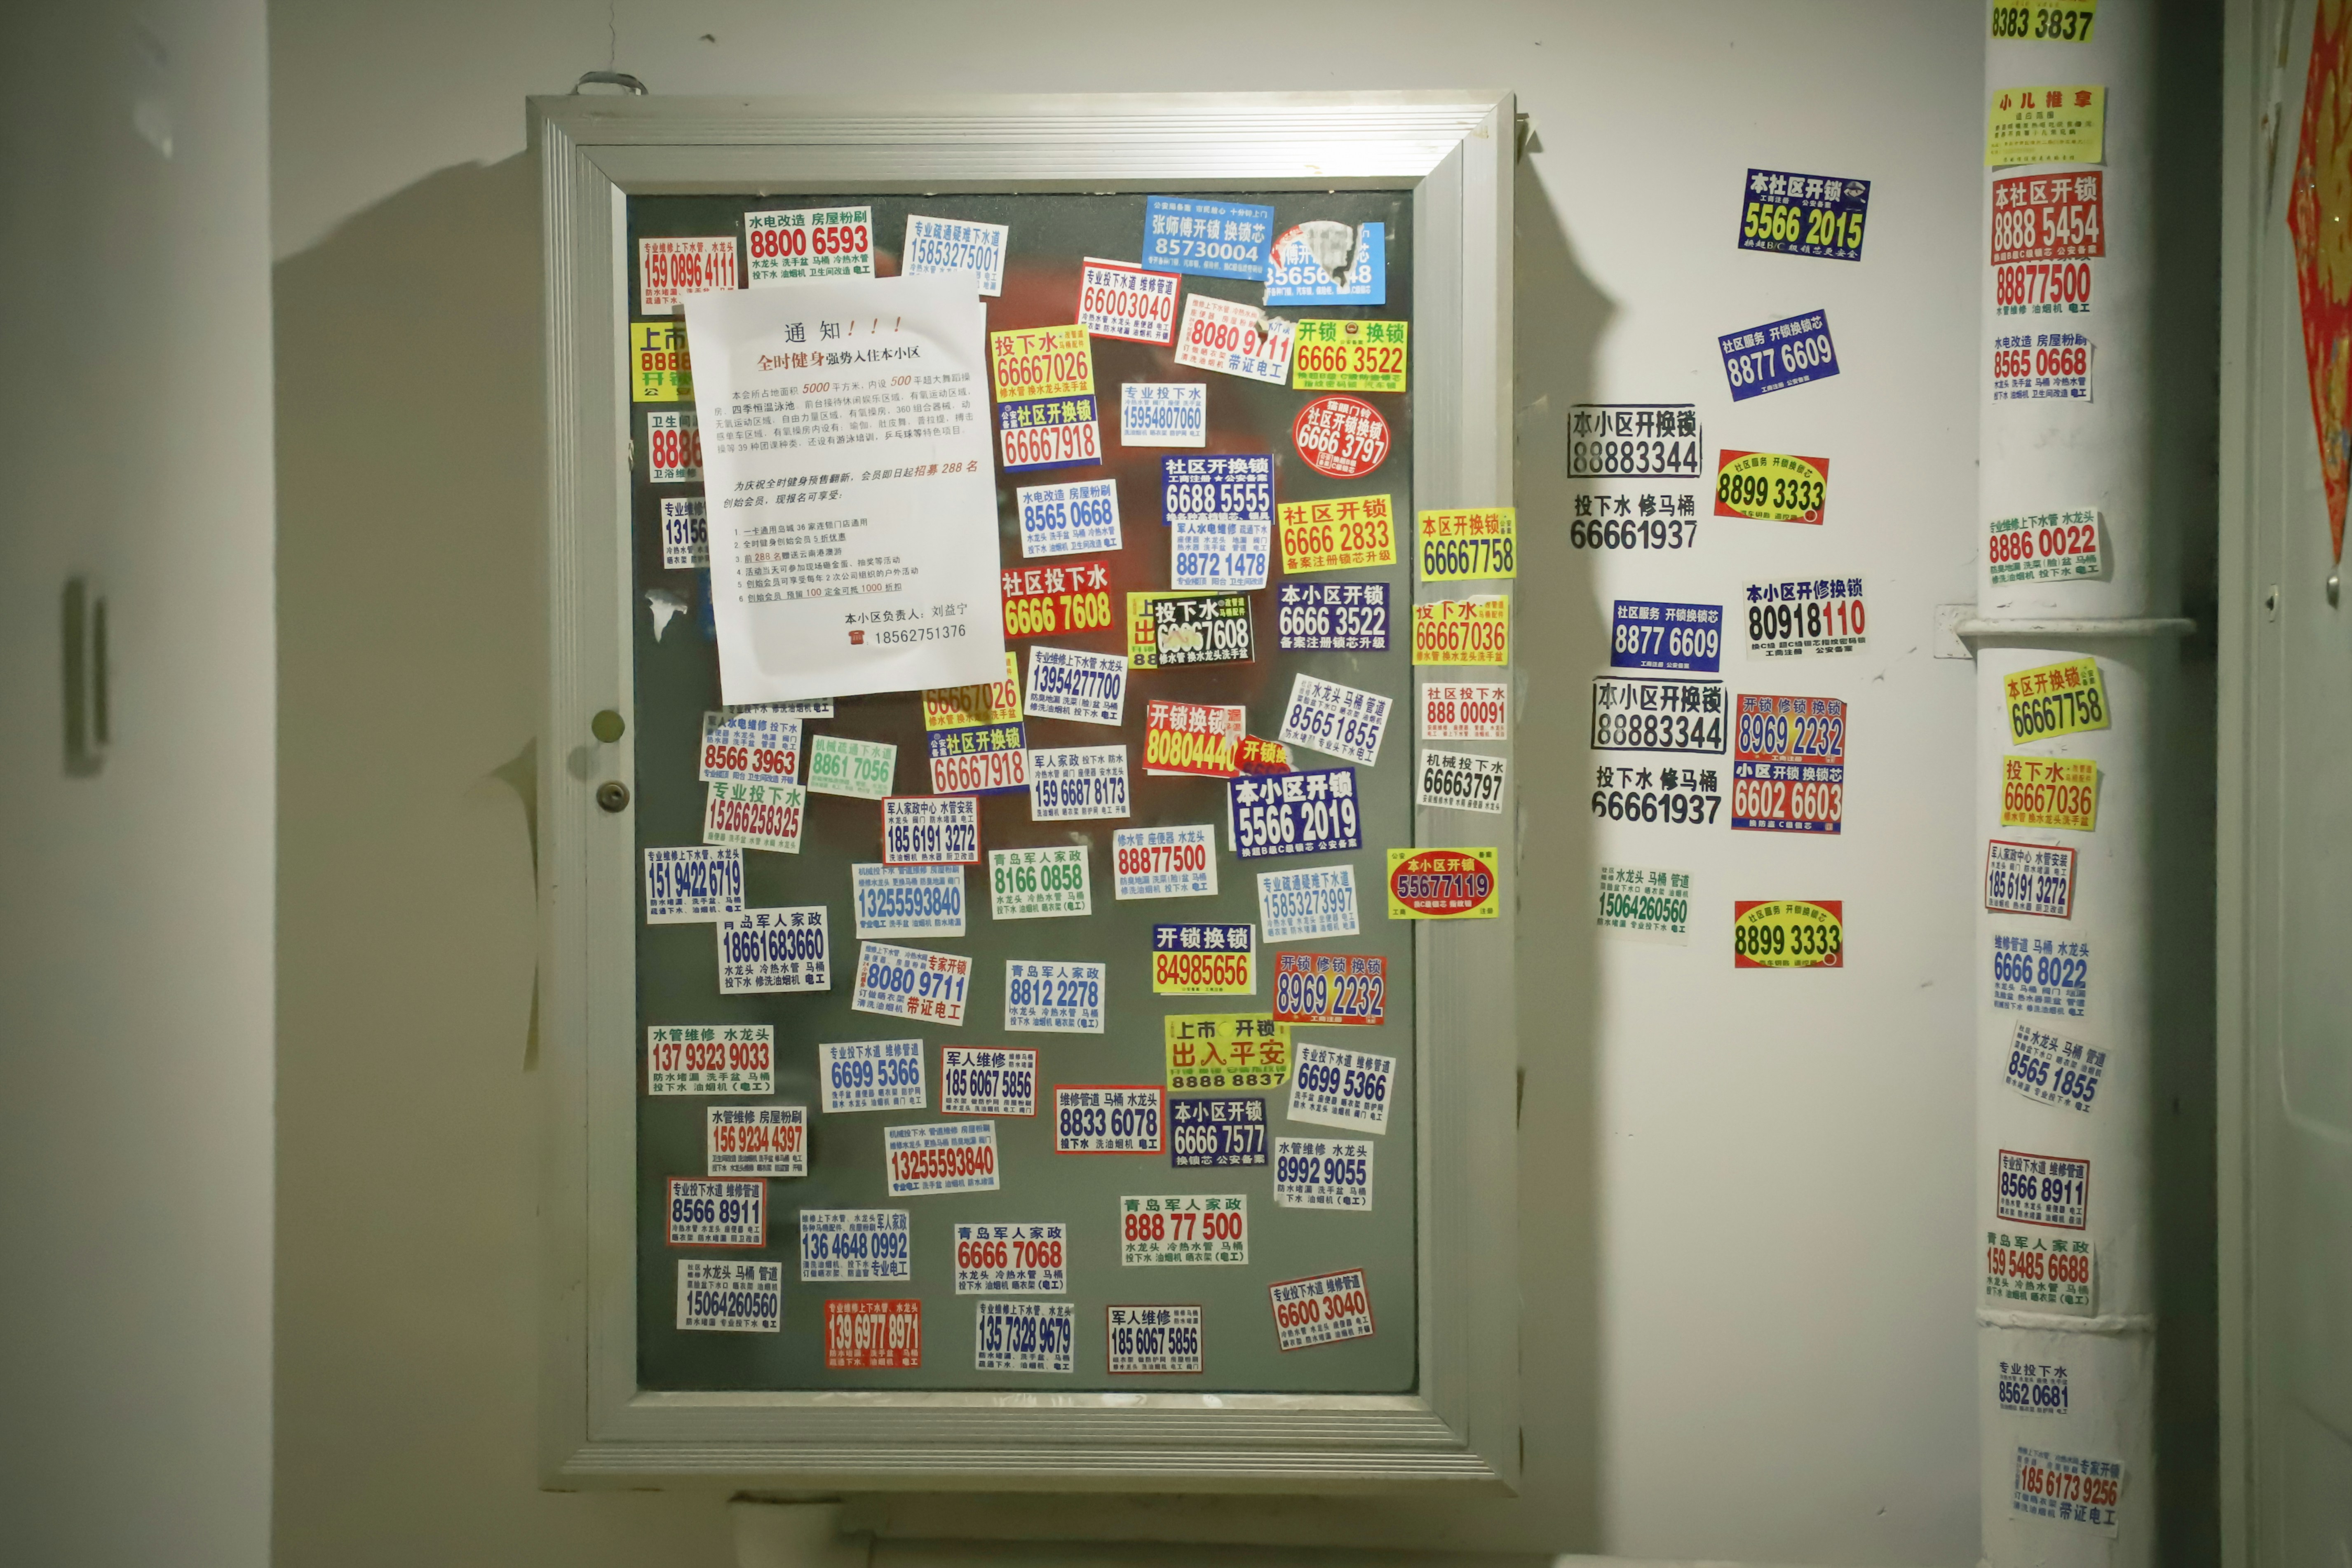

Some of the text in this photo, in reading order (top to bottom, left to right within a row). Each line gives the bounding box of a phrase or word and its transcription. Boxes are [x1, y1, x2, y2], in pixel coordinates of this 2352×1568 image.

[1993, 7, 2094, 40] 8383 3837
[1750, 173, 1843, 202] 本社区开锁
[1996, 176, 2097, 209] 本社区开锁
[749, 211, 866, 228] 水电改造 房屋粉刷
[915, 221, 1000, 246] 专业疏通疑难下水道
[1152, 215, 1265, 244] 张师傅开锁 换锁芯
[1744, 202, 1862, 249] 5566 2015
[1995, 204, 2099, 251] 8888 5454
[751, 225, 868, 258] 8800 6593
[912, 238, 998, 272] 15853275001
[1155, 238, 1258, 262] 85730004
[752, 254, 869, 268] 水龙头 洗手盆 马桶 冷热水管
[1087, 270, 1173, 295] 专业投下水道 维修管道
[1998, 263, 2091, 305] 88877500
[1084, 286, 1171, 322] 66003040
[2032, 303, 2063, 314] 油烟机
[2069, 303, 2090, 312] 电工
[1299, 322, 1404, 344] 开锁 换锁
[1723, 315, 1823, 354] 社区服务 开锁换锁芯
[757, 346, 920, 371] 全时健身强势入住本小区
[998, 351, 1088, 387] 66667026
[1298, 345, 1402, 373] 6666 3522
[1728, 335, 1832, 387] 8877 6609
[732, 386, 799, 400] 本会所占地面积
[802, 383, 830, 393] 5000
[890, 376, 911, 386] 500
[1124, 386, 1201, 399] 专业投下水
[1017, 399, 1091, 427] 社区开换锁
[1124, 406, 1201, 429] 15954807060
[1307, 407, 1383, 440] 社区开锁换锁
[1573, 410, 1696, 437] 本小区开换锁
[1005, 424, 1095, 464] 66667918
[1298, 424, 1385, 465] 6666 3797
[1574, 441, 1698, 473] 88883344
[1166, 459, 1269, 475] 社区开换锁
[1575, 494, 1695, 517] 投下水 修马桶
[1718, 474, 1823, 511] 8899 3333
[1284, 499, 1387, 526] 社区开锁
[1177, 523, 1237, 534] 军人水电维修
[1284, 520, 1390, 556] 6666 2833
[1570, 520, 1697, 549] 66661937
[1424, 538, 1513, 575] 66667758
[1990, 525, 2096, 563] 8886 0022
[1177, 553, 1265, 576] 8872 1478
[1287, 550, 1391, 570] 备案注册锁芯升级
[1002, 564, 1108, 597] 社区投下水
[1749, 599, 1865, 640] 80918110
[876, 625, 966, 644] 18562751376
[1417, 622, 1505, 650] 66667036
[1034, 665, 1120, 700] 13954277700
[1428, 688, 1505, 700] 社区投下水
[2008, 667, 2080, 699] 本区开换锁
[1030, 702, 1117, 720] 修洗油烟机 投下水 电工
[1428, 702, 1504, 723] 888 00091
[813, 752, 889, 783] 8861 7056
[1427, 754, 1504, 774] 机械投下水
[2007, 760, 2064, 783] 投下水
[1235, 771, 1353, 806] 本小区开锁
[1424, 768, 1502, 800] 66663797
[711, 799, 799, 838] 15266258325
[887, 801, 973, 815] 军人家政中心 水管安装
[888, 824, 974, 852] 185 6191 3272
[994, 851, 1082, 866] 青岛军人家政
[1408, 859, 1475, 872] 本小区开锁
[995, 864, 1083, 894] 8166 0858
[1398, 874, 1488, 898] 55677119
[1616, 869, 1689, 888] 水龙头 马桶 管道
[859, 887, 960, 917] 13255593840
[724, 928, 824, 963] 18661683660
[1157, 927, 1249, 949] 开锁换锁
[725, 974, 824, 988] 投下水 修洗油烟机 电工
[1157, 954, 1247, 985] 84985656
[654, 1028, 770, 1041] 水管维修 水龙头
[653, 1043, 769, 1071] 137 9323 9033
[947, 1052, 1006, 1068] 军人维修
[1173, 1039, 1285, 1067] 出入平安
[653, 1072, 770, 1082] 防水堵漏 洗手盆 马桶
[1172, 1073, 1285, 1088] 8888 8837
[1060, 1093, 1157, 1107] 维修管道 马桶 水龙头
[1278, 1156, 1366, 1185] 8992 9055
[2001, 1172, 2083, 1205] 8566 8911
[1124, 1198, 1242, 1211] 青岛军人家政
[1125, 1212, 1242, 1241] 888 77 500
[1988, 1247, 2089, 1283] 159 5485 6688
[687, 1291, 778, 1318] 15064260560
[1278, 1291, 1365, 1328] 6600 3040
[829, 1314, 918, 1349] 139 6977 8971
[2000, 1361, 2067, 1378] 专业投下水
[1999, 1381, 2068, 1407] 8562 0681
[2022, 1465, 2117, 1506] 185 6173 9256
[2060, 1502, 2115, 1526] 带证电工
